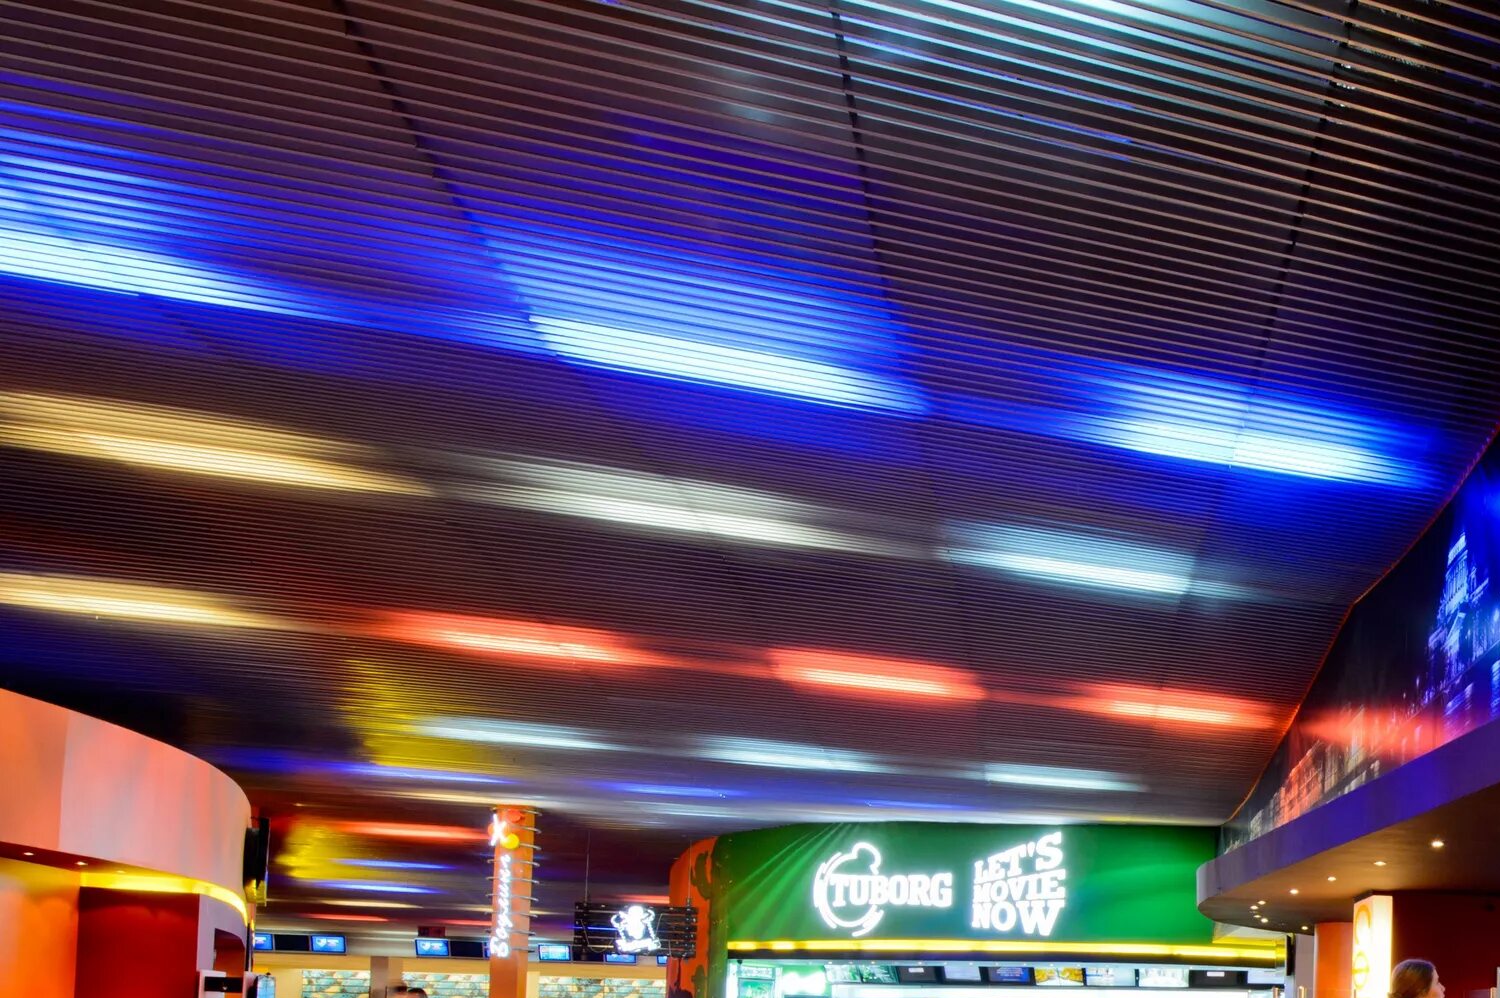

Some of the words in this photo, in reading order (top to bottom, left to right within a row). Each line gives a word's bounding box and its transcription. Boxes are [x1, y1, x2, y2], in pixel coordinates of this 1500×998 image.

[973, 831, 1064, 885] LET'S
[829, 872, 953, 908] TUBORG
[972, 868, 1067, 903] MOVIE
[971, 898, 1066, 937] NOW
